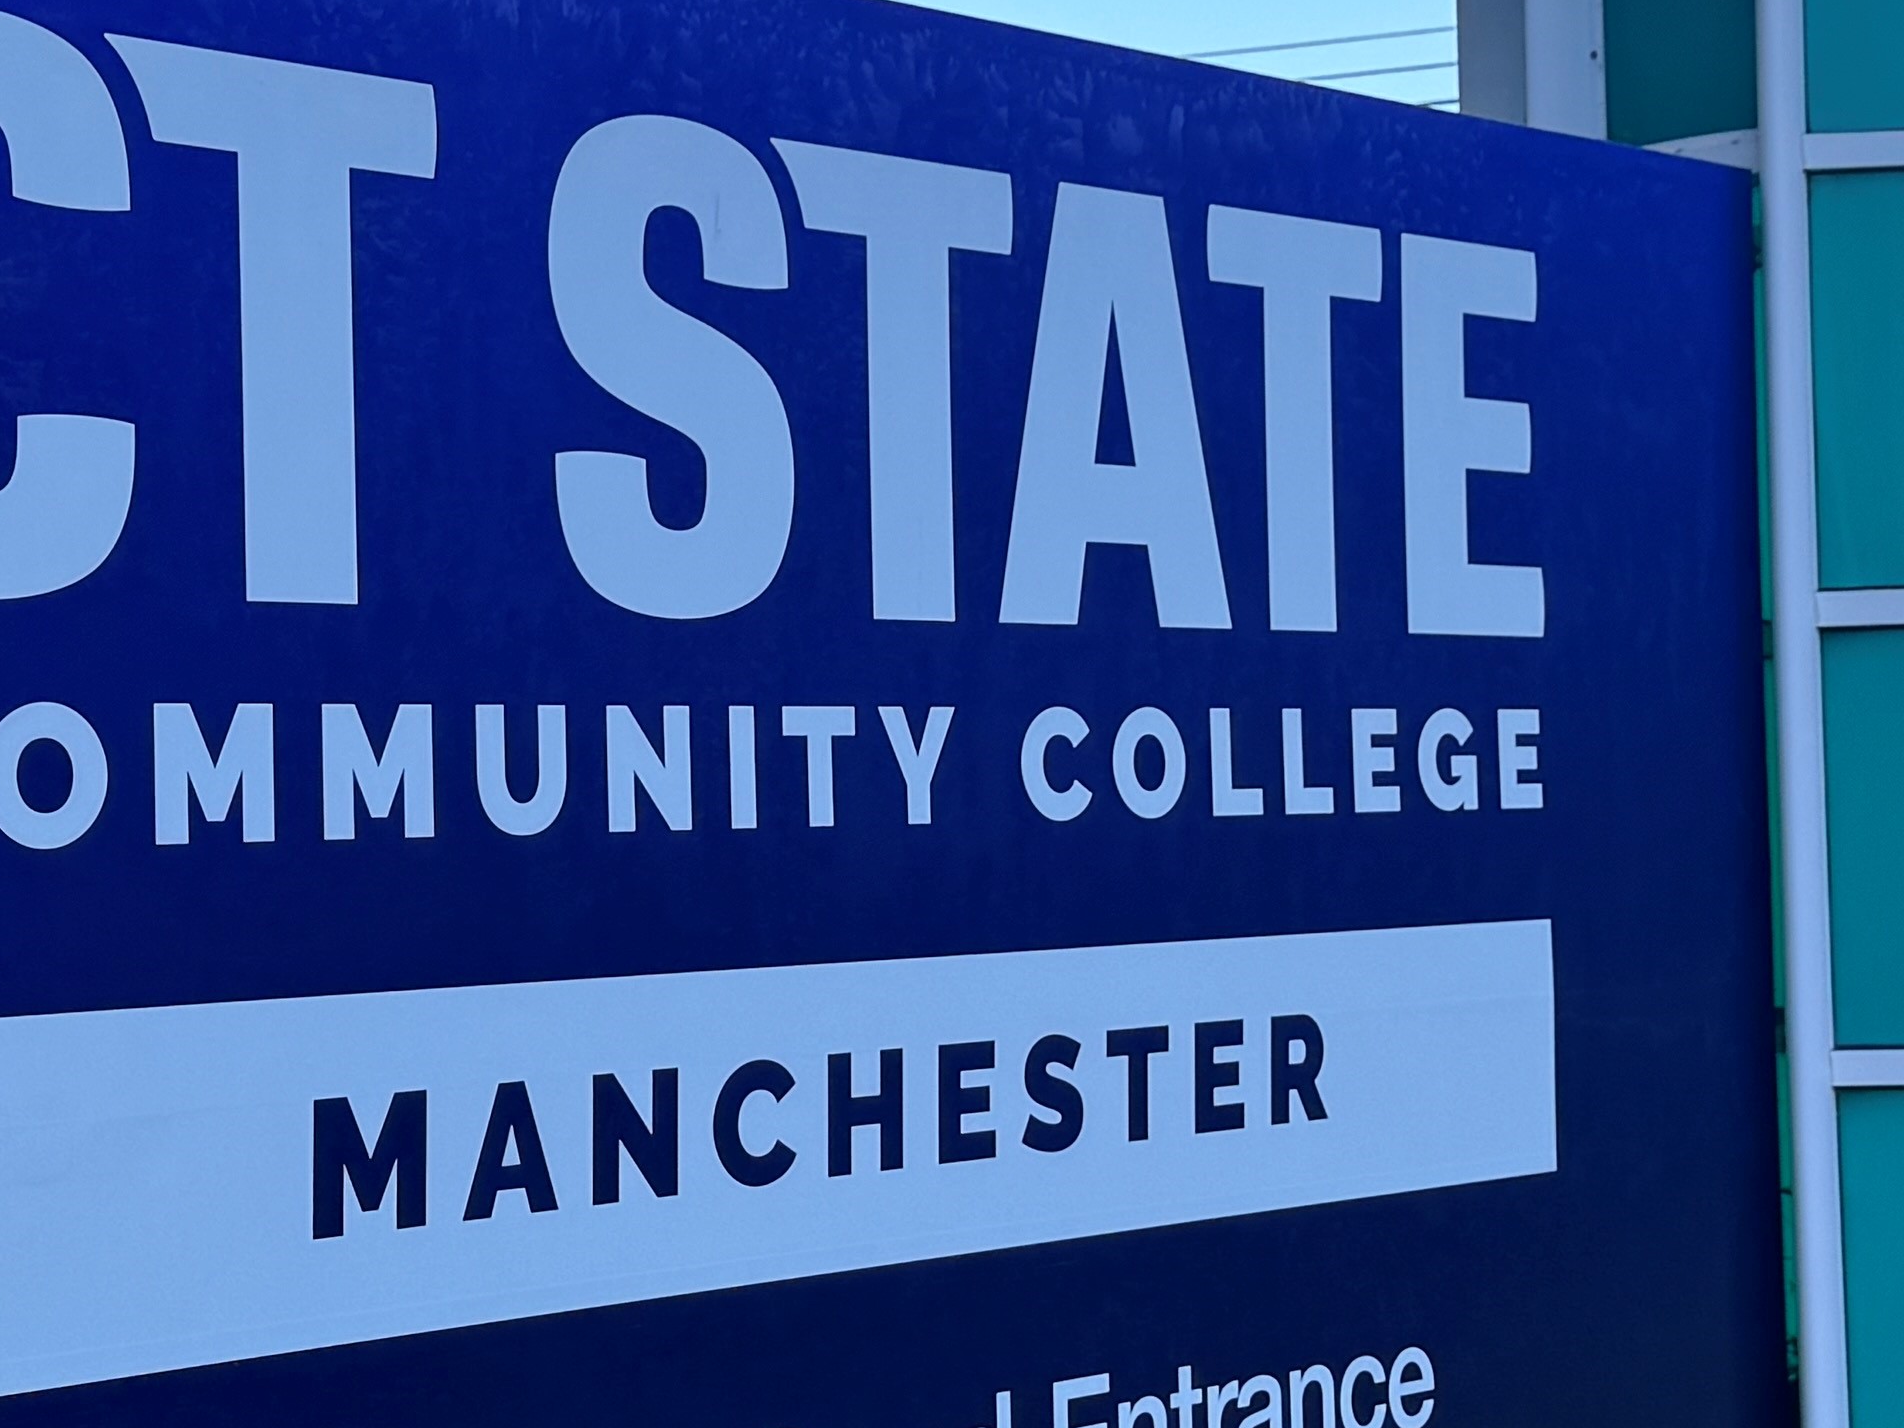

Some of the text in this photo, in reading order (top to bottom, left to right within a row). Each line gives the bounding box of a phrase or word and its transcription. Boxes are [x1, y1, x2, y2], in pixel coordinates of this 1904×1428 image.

[549, 115, 1544, 638] STATE
[1020, 706, 1544, 822] COLLEGE
[312, 1013, 1329, 1241] MANCHESTER
